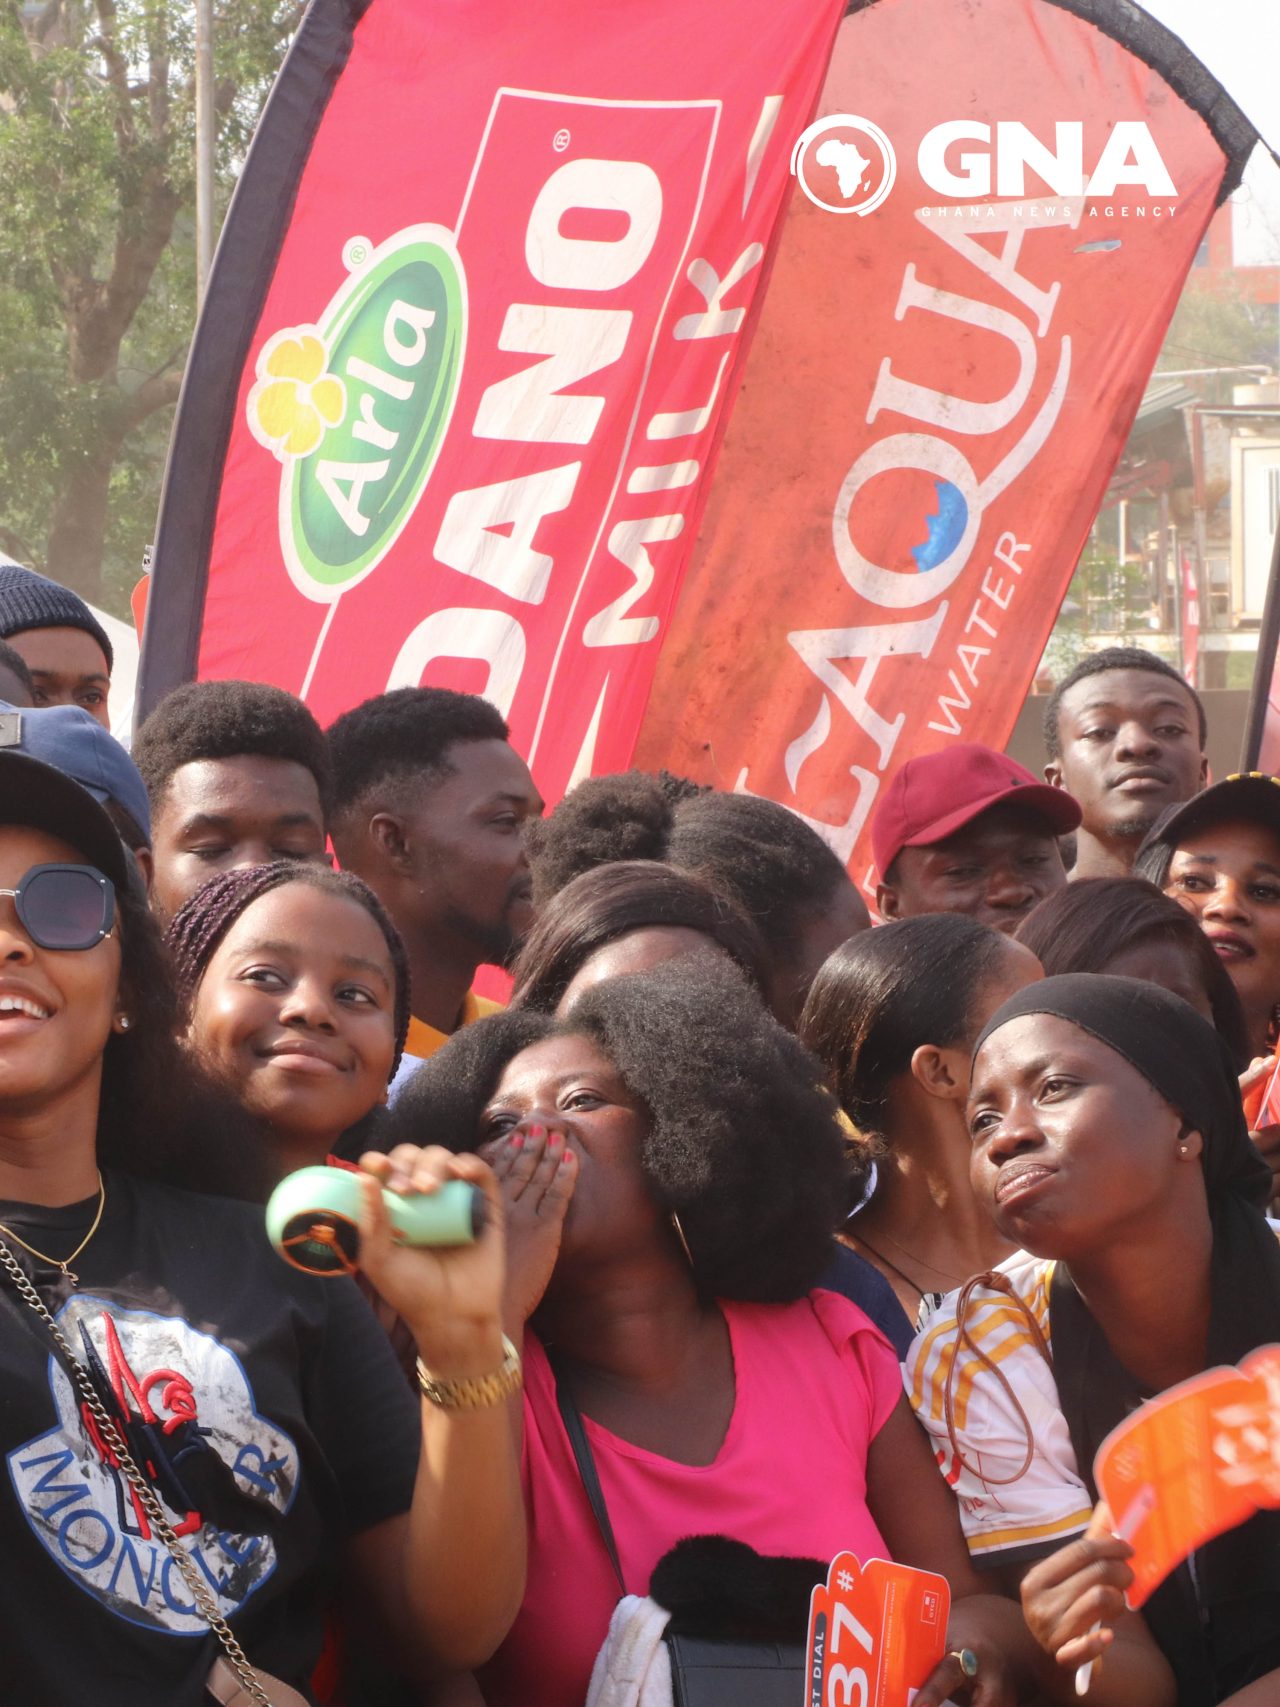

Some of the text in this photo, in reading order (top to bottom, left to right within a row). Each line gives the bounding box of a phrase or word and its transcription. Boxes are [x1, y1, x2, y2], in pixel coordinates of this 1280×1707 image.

[313, 299, 436, 537] Arla
[385, 158, 663, 722] DANO
[582, 242, 763, 647] MILK
[927, 530, 1032, 736] WATER
[813, 1631, 825, 1679] DIAL
